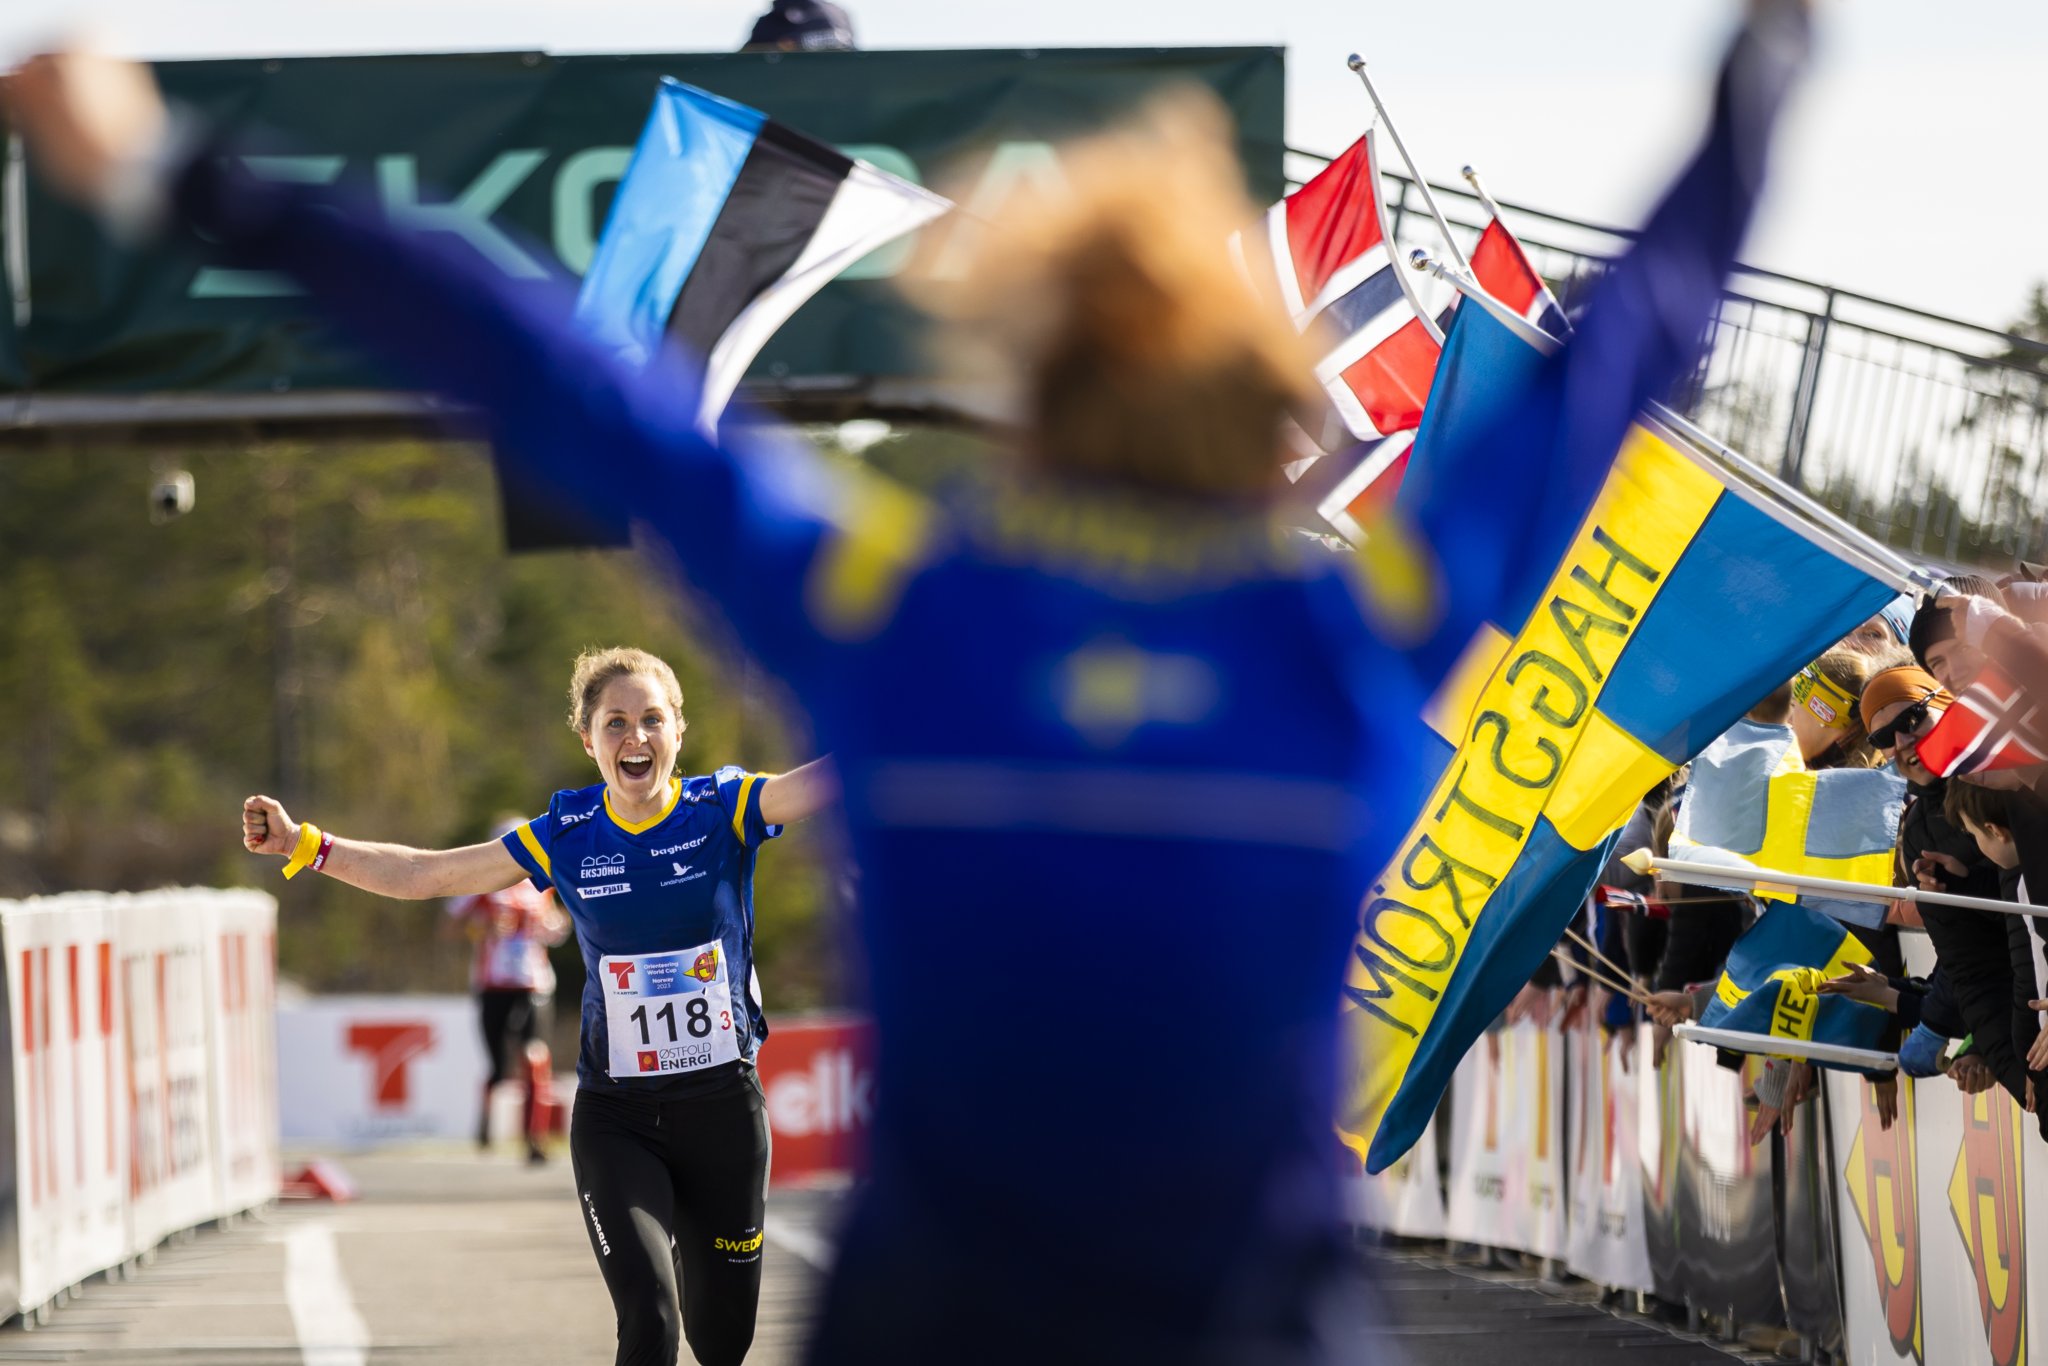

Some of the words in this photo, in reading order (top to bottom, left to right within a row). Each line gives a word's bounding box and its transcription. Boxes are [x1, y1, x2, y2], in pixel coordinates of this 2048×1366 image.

[581, 865, 626, 879] EKSJÖHUS
[643, 961, 679, 970] Orienteering
[646, 968, 665, 976] World
[666, 967, 678, 975] Cup
[630, 998, 712, 1045] 118
[720, 1010, 732, 1031] 3
[659, 1042, 712, 1060] ØSTFOLD
[660, 1053, 712, 1071] ENERGI
